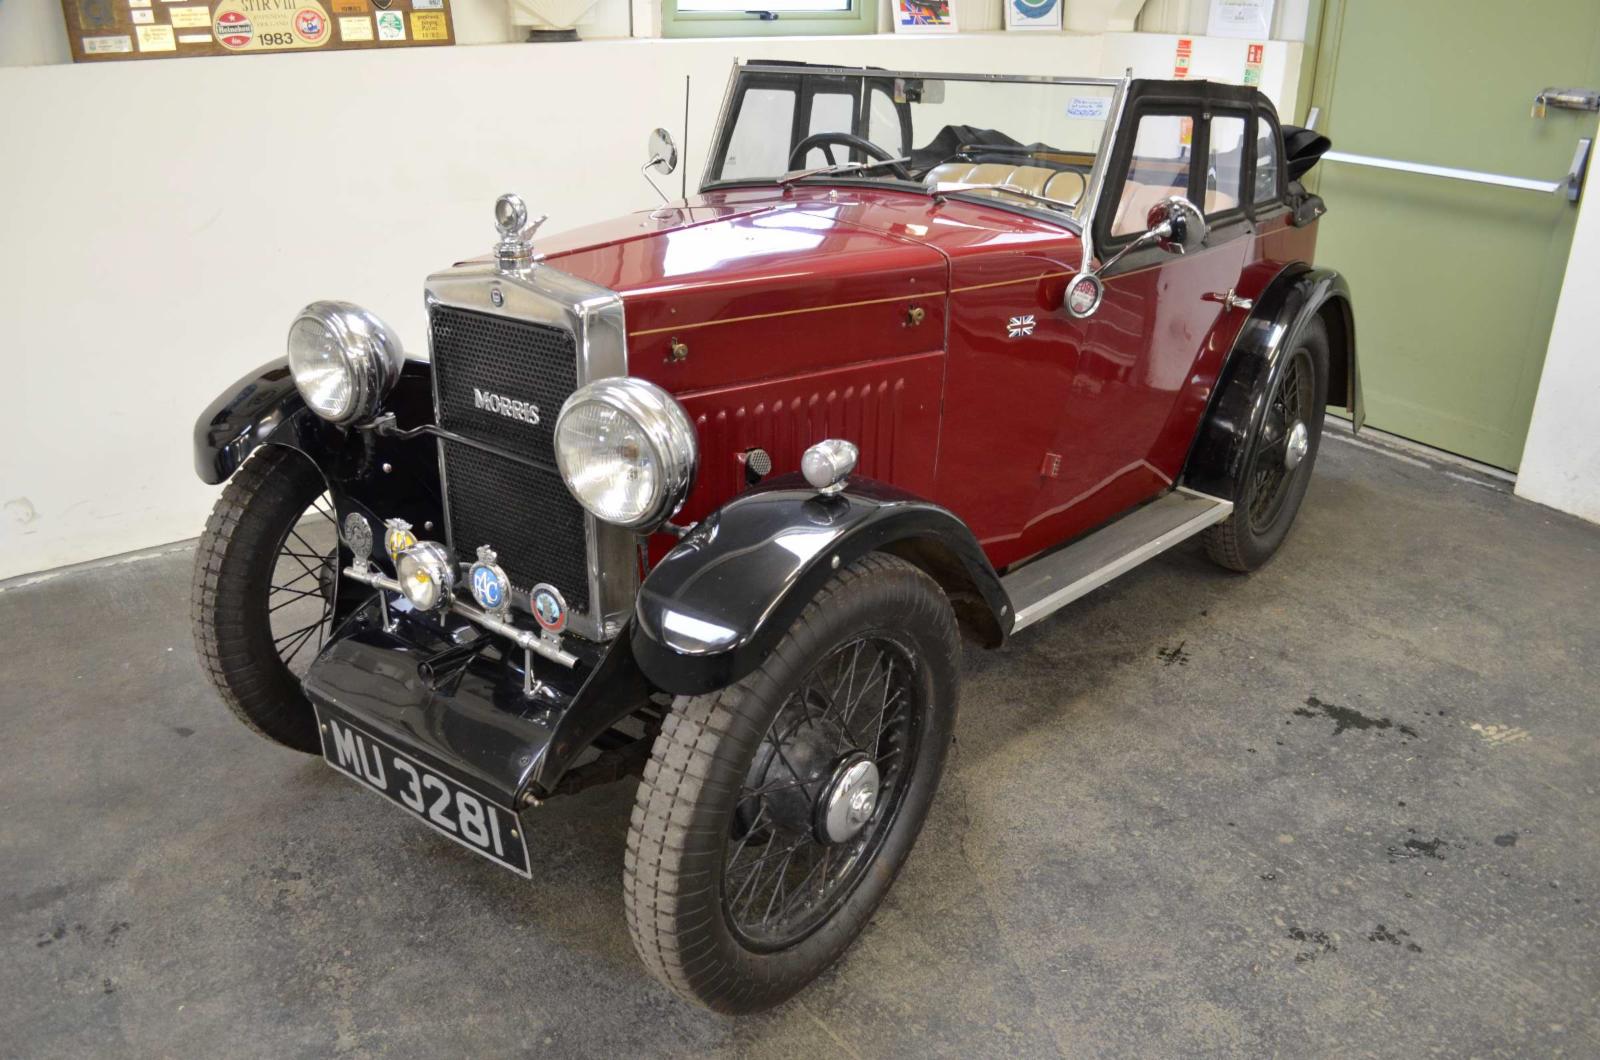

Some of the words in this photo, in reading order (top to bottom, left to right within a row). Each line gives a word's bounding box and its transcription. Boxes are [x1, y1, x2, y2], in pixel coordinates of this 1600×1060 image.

[217, 25, 251, 34] Heineken
[258, 33, 294, 46] 1983
[473, 388, 540, 424] MORRIS
[474, 571, 498, 605] RAC
[329, 719, 388, 790] MU
[393, 757, 504, 857] 3281
